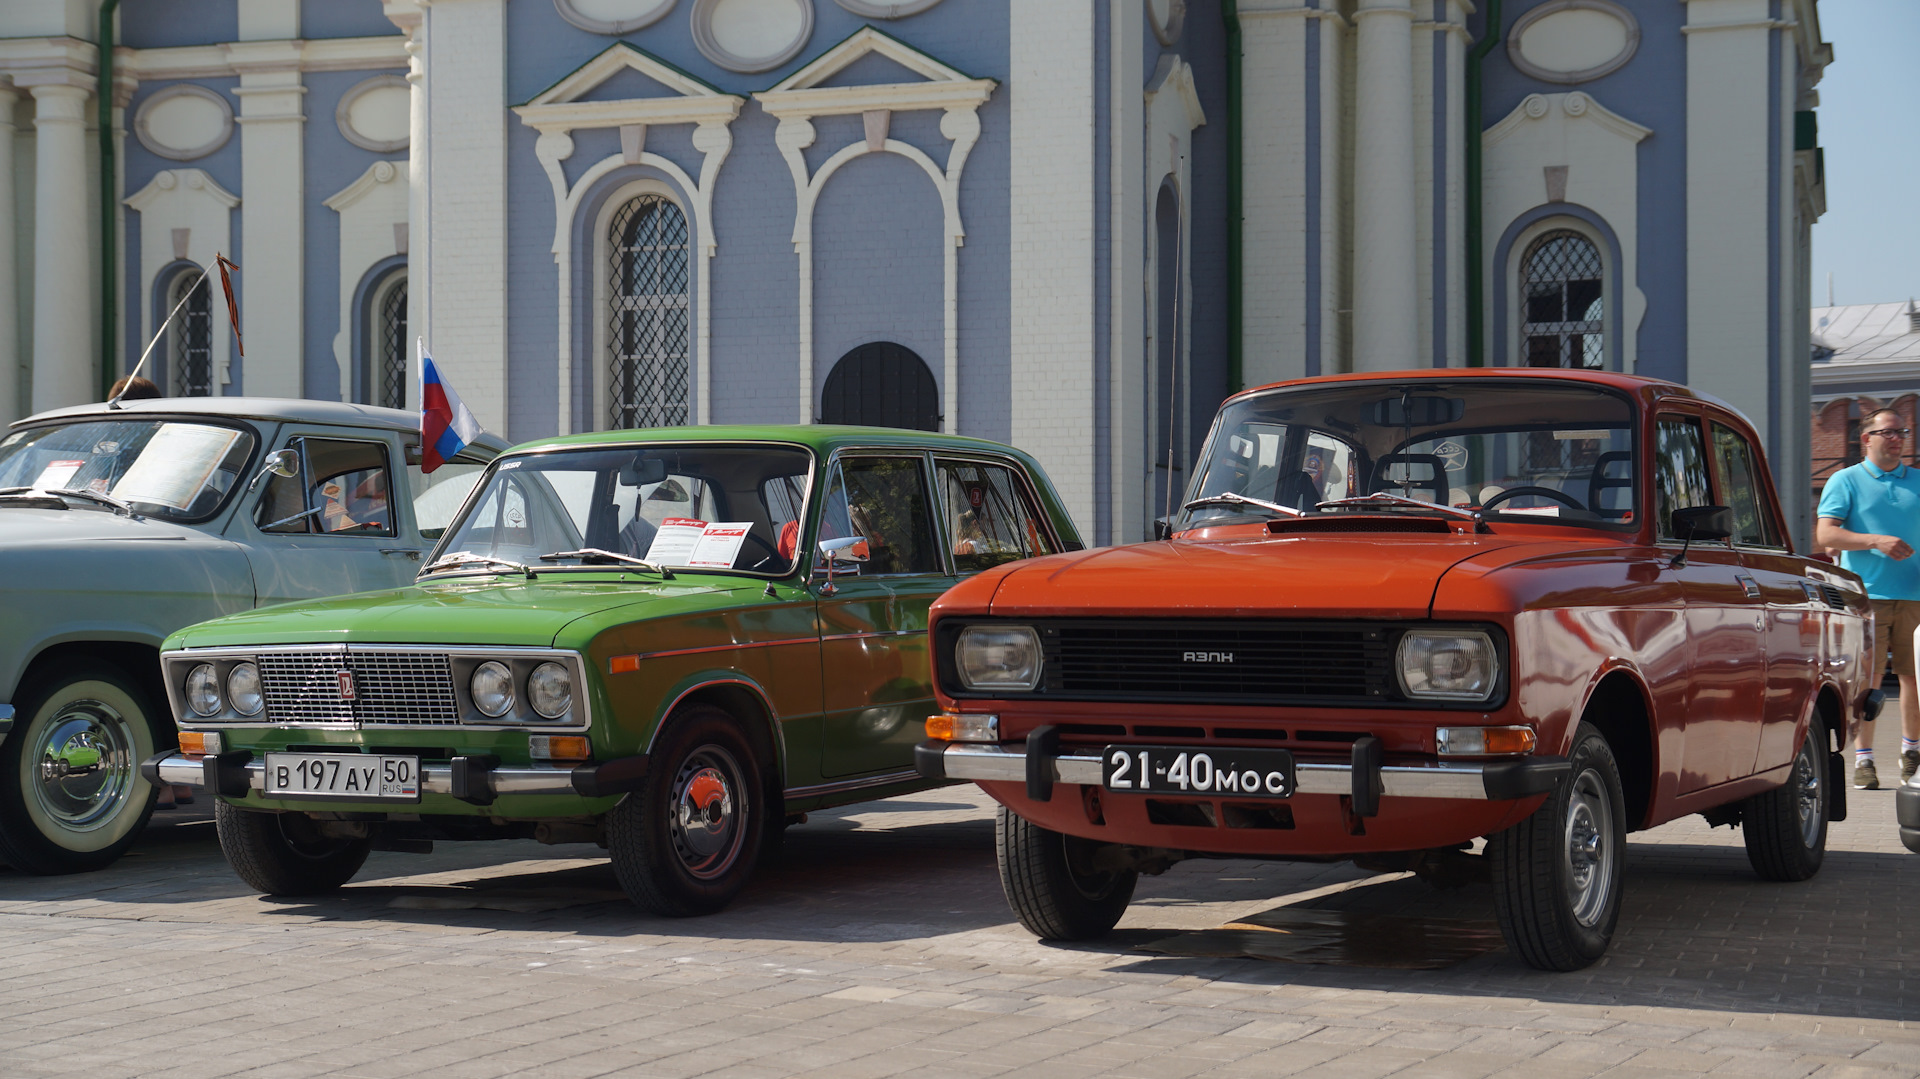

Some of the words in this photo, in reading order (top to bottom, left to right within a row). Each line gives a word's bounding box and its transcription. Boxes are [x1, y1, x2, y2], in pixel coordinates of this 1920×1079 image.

[499, 461, 522, 471] USSR
[383, 759, 410, 784] 50
[382, 784, 402, 794] RUS
